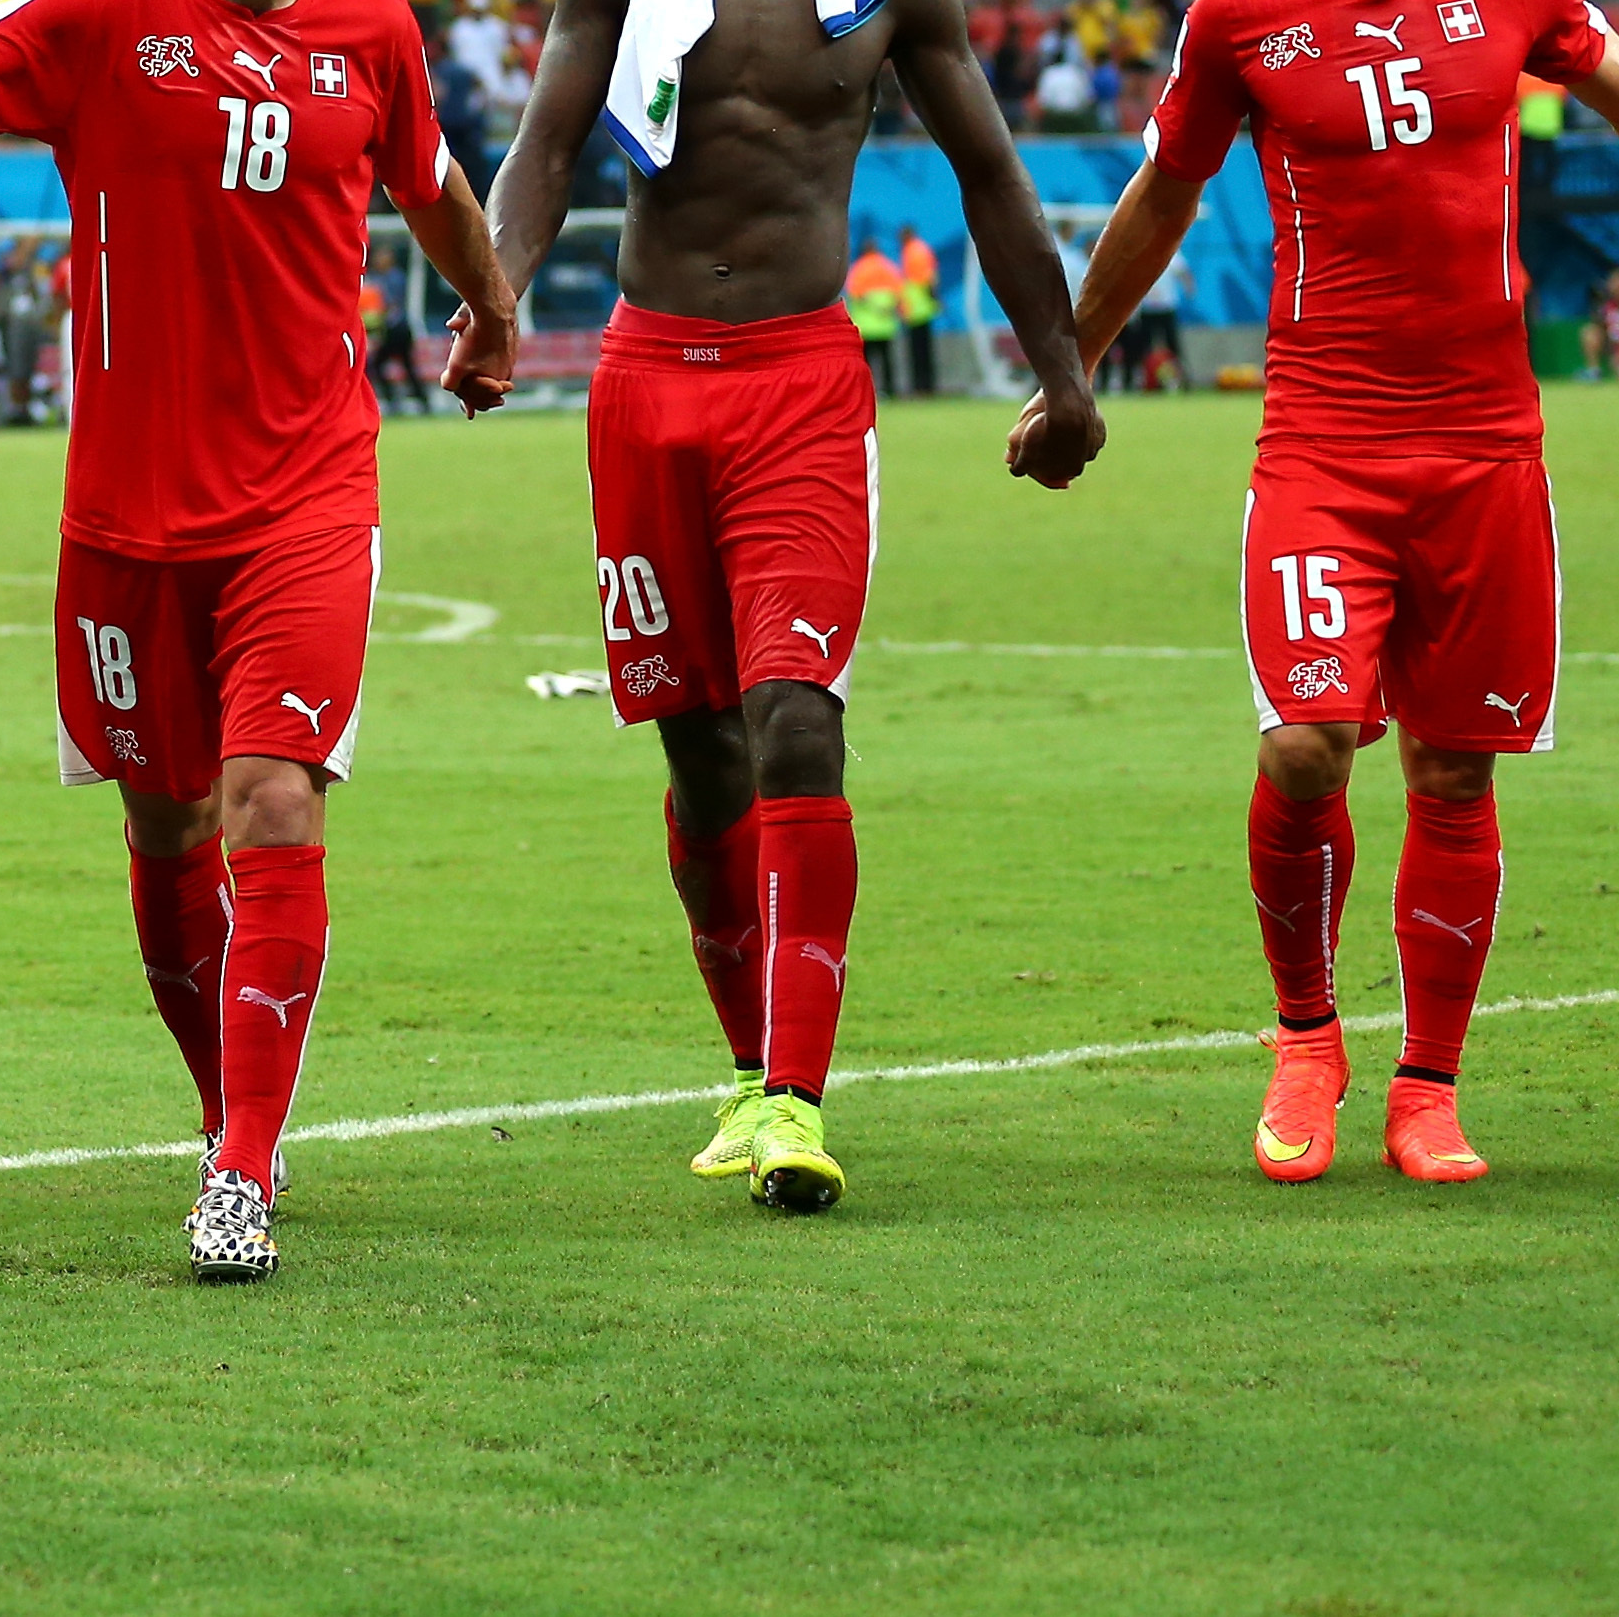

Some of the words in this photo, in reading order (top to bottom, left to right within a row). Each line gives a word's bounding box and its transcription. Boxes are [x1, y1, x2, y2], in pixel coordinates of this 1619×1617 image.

[218, 96, 290, 192] 18
[1345, 57, 1433, 151] 15
[683, 347, 721, 362] SUISSE
[598, 555, 669, 641] 20
[1271, 555, 1347, 641] 15
[77, 616, 137, 710] 18
